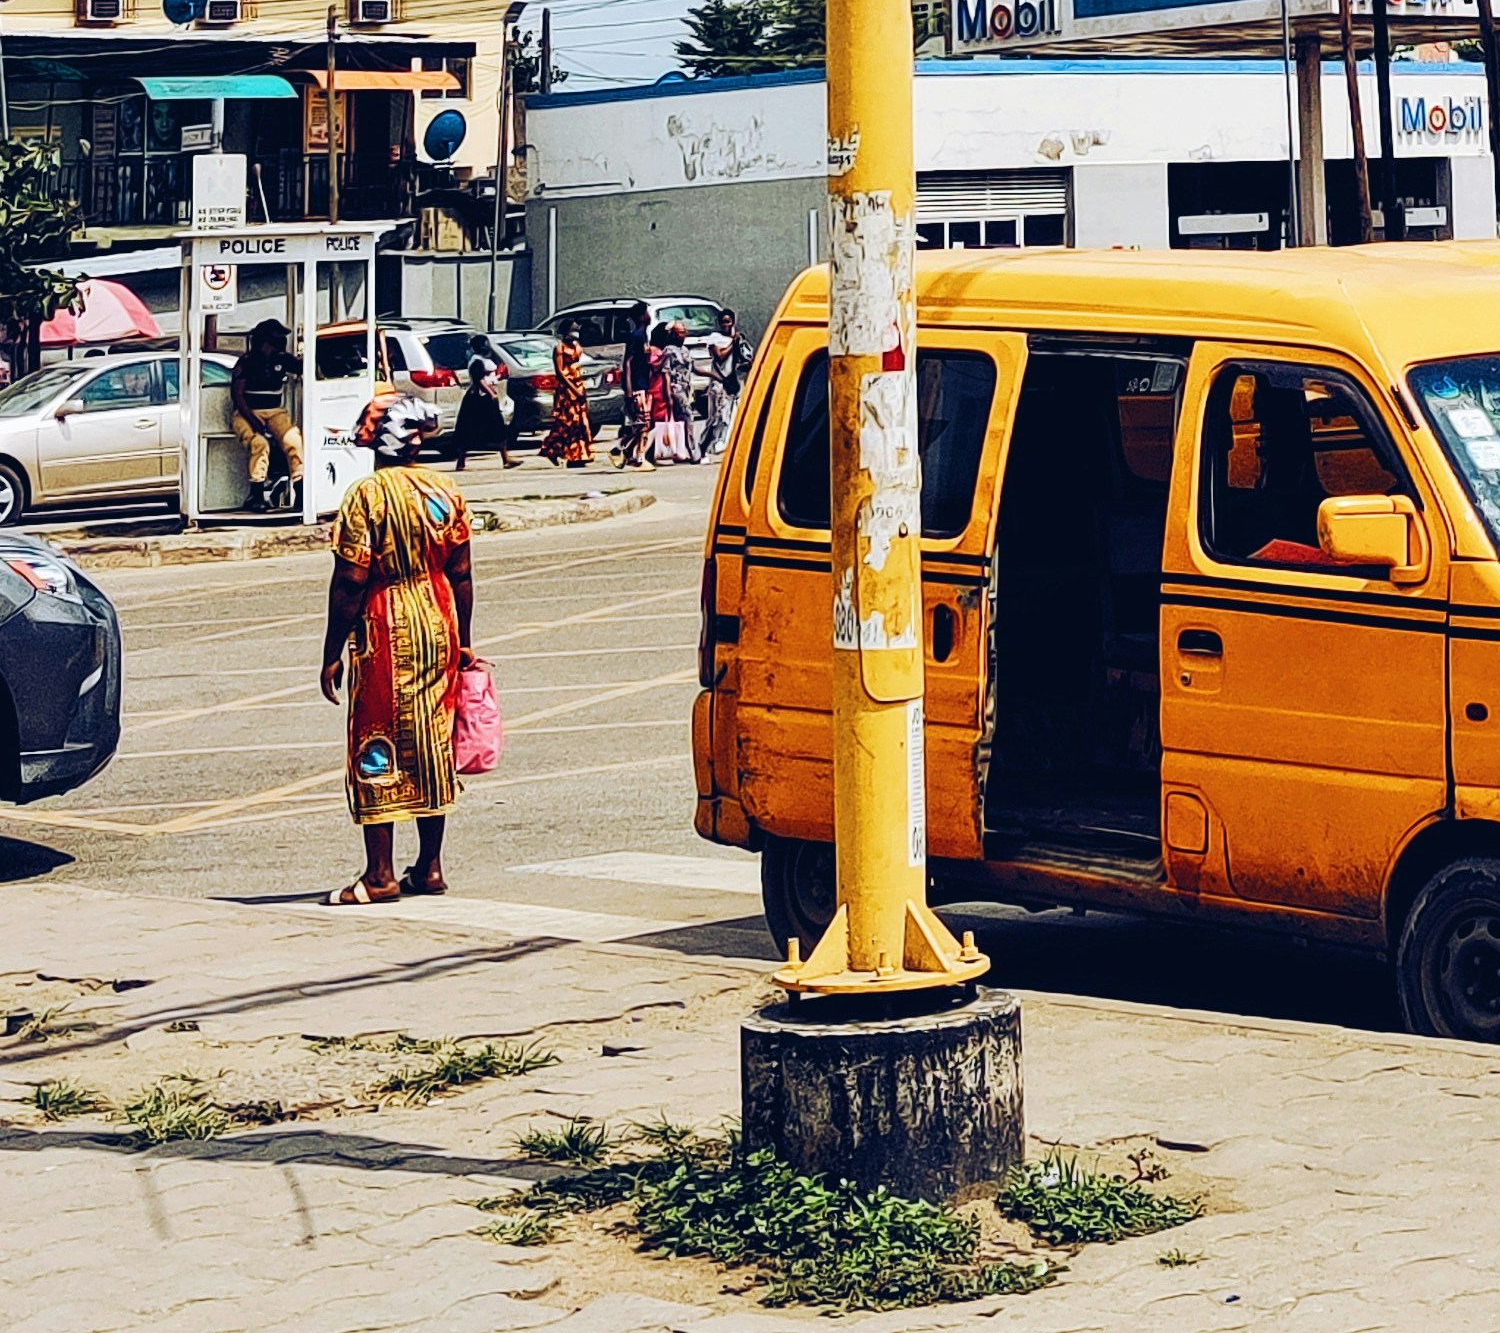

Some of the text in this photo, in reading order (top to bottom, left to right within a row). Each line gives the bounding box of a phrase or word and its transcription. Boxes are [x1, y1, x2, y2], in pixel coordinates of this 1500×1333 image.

[1402, 97, 1482, 132] Mobil
[220, 239, 286, 254] POLICE
[326, 237, 361, 251] POLICE
